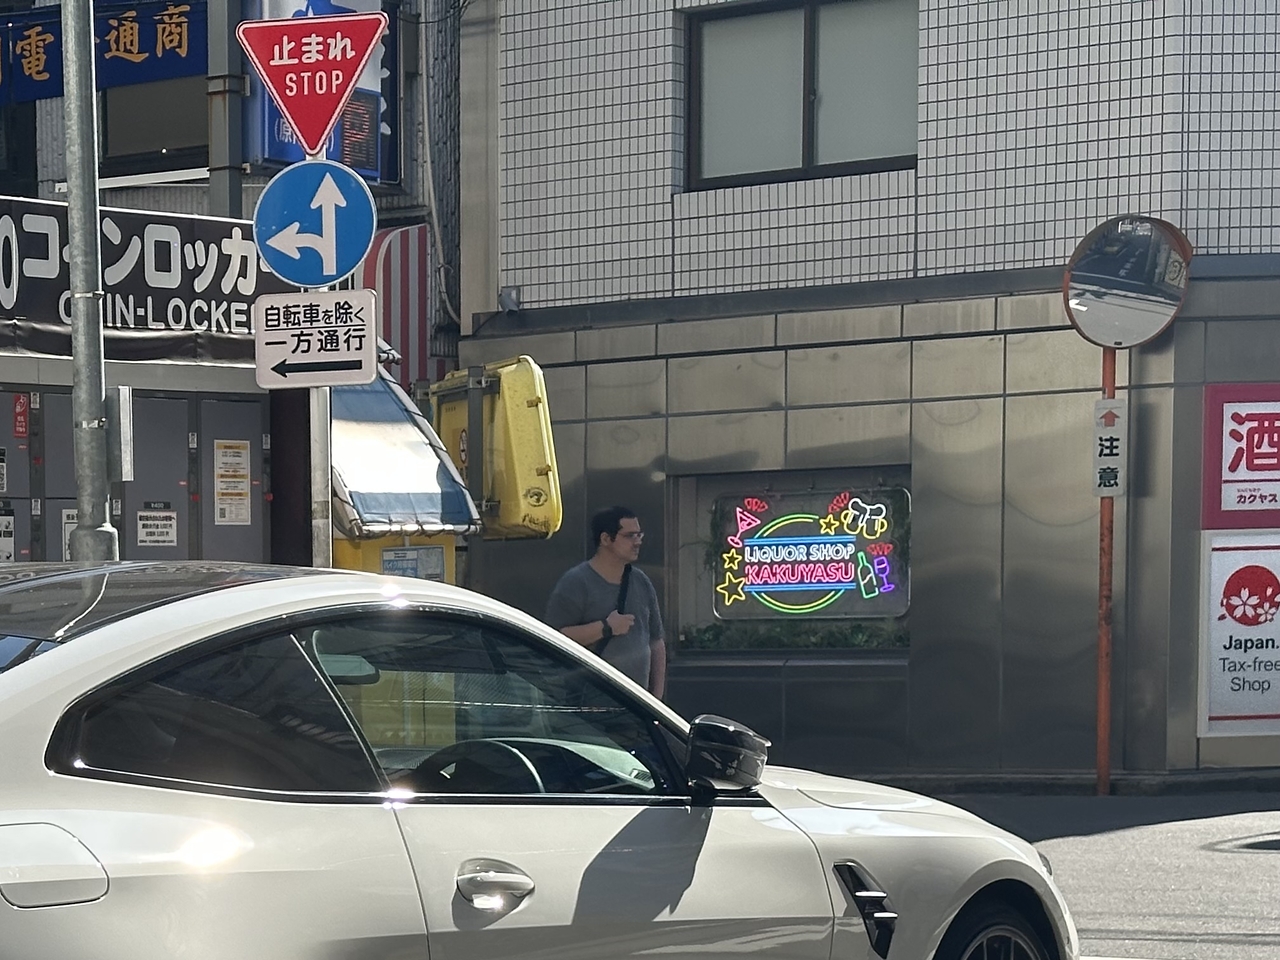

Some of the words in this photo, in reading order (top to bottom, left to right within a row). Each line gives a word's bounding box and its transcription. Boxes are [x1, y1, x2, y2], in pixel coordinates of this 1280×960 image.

[269, 31, 356, 66] 止まれ
[285, 69, 344, 97] STOP
[58, 290, 256, 334] CIN-LOCKE
[264, 300, 365, 328] 自転車を除く
[264, 328, 366, 354] 一方通行
[1228, 411, 1280, 473] 酒
[1097, 436, 1120, 488] 注意
[1236, 493, 1278, 504] カクヤス
[744, 544, 808, 563] LIQUOR
[809, 543, 856, 561] SHOP
[744, 561, 856, 585] KAKUYASU
[1222, 634, 1280, 654] Japan.
[1218, 656, 1280, 673] Tax-free
[1229, 676, 1271, 694] Shop
